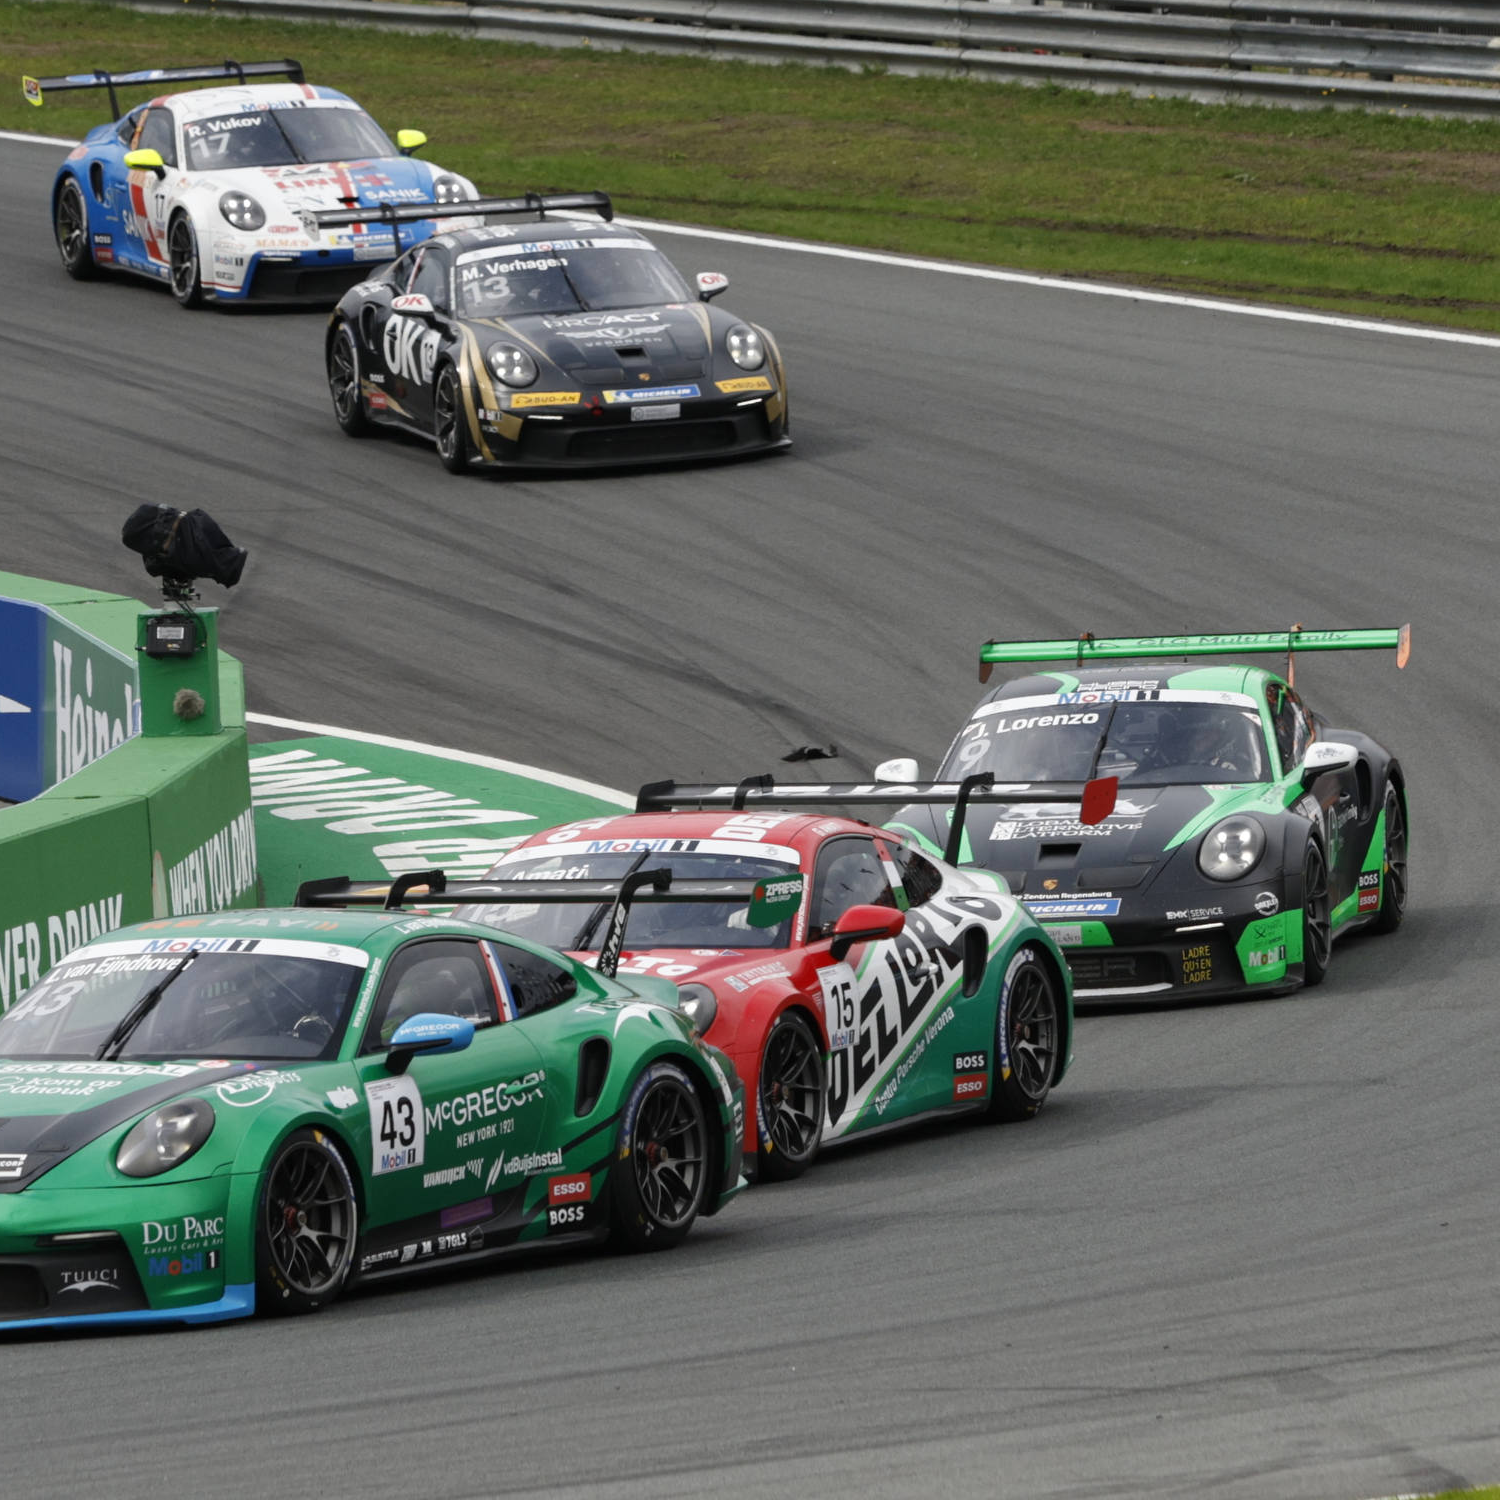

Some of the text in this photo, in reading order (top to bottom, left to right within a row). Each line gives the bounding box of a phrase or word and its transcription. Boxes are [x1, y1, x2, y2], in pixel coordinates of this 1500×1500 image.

[188, 116, 261, 138] R. Vukov
[190, 133, 231, 160] 17
[462, 256, 569, 282] M. Verhagen
[463, 275, 511, 305] 13
[383, 313, 426, 387] OK
[632, 387, 691, 399] MICHELIN
[1058, 690, 1130, 705] Mobil
[971, 710, 1100, 740] J. Lorenzo
[586, 839, 667, 855] Mobil
[765, 880, 802, 897] ZPRESS
[1359, 873, 1379, 887] BOSS
[1023, 893, 1060, 901] Zentrum
[1060, 891, 1113, 901] Regensburg
[1359, 895, 1378, 906] ESSO
[1190, 907, 1224, 918] SERVICE
[143, 939, 228, 953] Mobil
[1182, 945, 1211, 961] LADRE
[1249, 947, 1279, 967] Mobil
[63, 964, 92, 979] van
[1183, 970, 1212, 985] LADRE
[831, 981, 855, 1032] 15
[874, 1006, 956, 1115] Centro Porsche Verona
[955, 1054, 985, 1070] BOSS
[25, 1076, 122, 1091] Kom op
[956, 1080, 983, 1094] ESSO
[380, 1096, 416, 1150] 43
[456, 1117, 515, 1149] NEW YORK 1921
[381, 1151, 406, 1170] Mobil
[553, 1180, 586, 1197] ESSO
[549, 1206, 585, 1226] BOSS
[148, 1252, 204, 1277] Mobil
[60, 1268, 118, 1284] TUUCI
